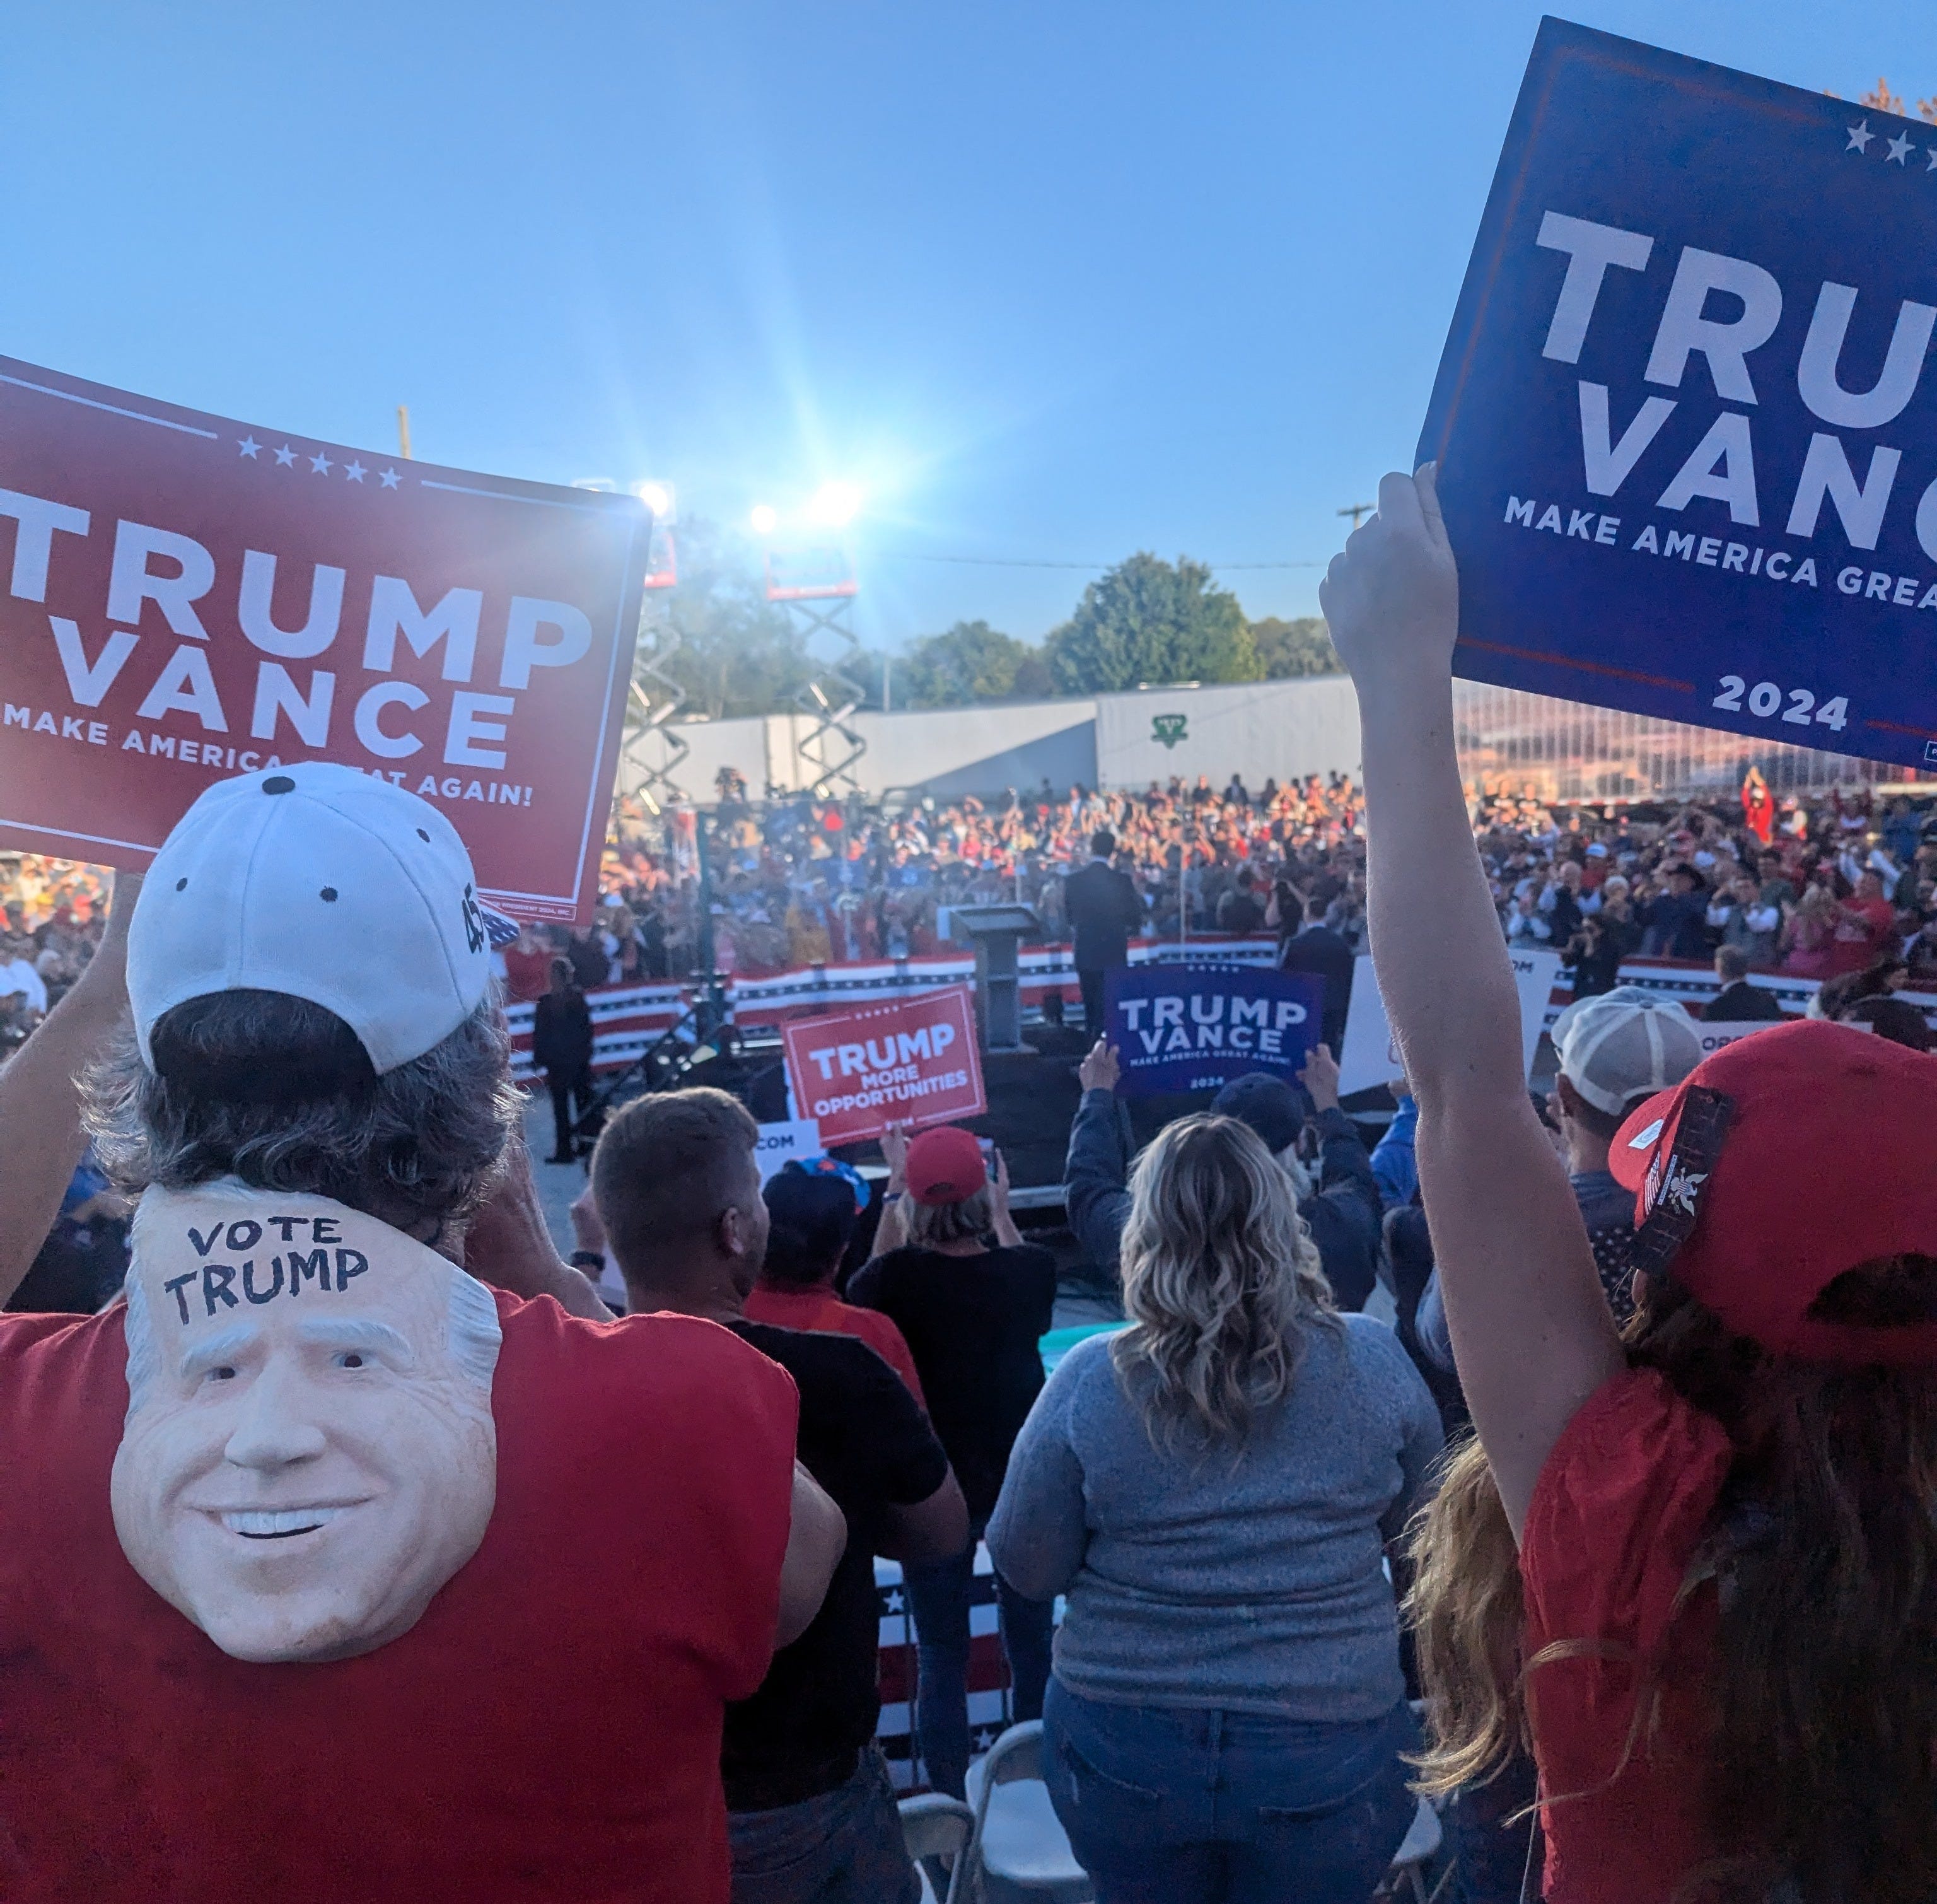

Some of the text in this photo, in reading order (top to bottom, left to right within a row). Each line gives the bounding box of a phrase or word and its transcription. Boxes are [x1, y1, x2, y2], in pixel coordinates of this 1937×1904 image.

[1578, 380, 1937, 564] VAN
[1504, 496, 1621, 546] MAKE
[1632, 524, 1818, 587] AMERICA
[0, 488, 592, 690] TRUMP
[48, 615, 515, 769] VANCE
[1712, 675, 1849, 732] 2024
[3, 703, 108, 746] MAKE
[122, 729, 282, 773] AMERICA
[417, 774, 533, 807] AGAIN!
[1118, 995, 1307, 1031] TRUMP
[1139, 1024, 1283, 1054] VANCE
[808, 1023, 955, 1080] TRUMP
[861, 1064, 919, 1090] MORE
[813, 1069, 969, 1116] OPPORTUNITIES
[187, 1216, 342, 1256] VOTE
[163, 1248, 369, 1325] TRUMP
